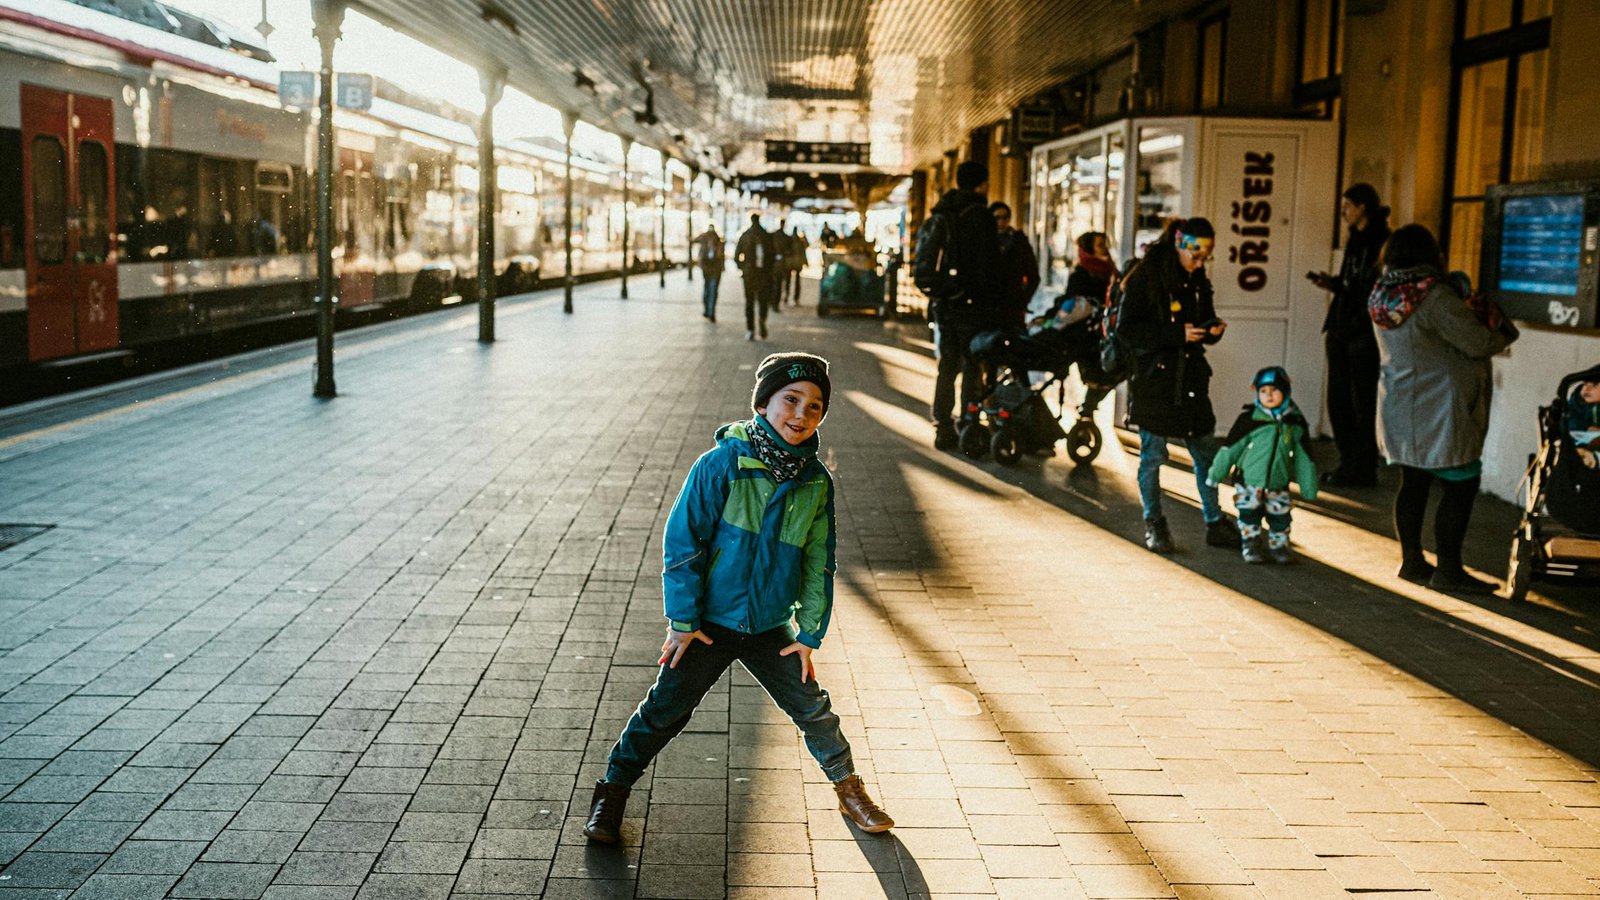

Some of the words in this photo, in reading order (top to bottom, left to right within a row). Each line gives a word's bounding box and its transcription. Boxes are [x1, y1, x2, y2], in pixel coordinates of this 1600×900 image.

[289, 84, 304, 106] 3
[345, 86, 362, 107] B
[1228, 151, 1275, 292] OŘÍŠEK
